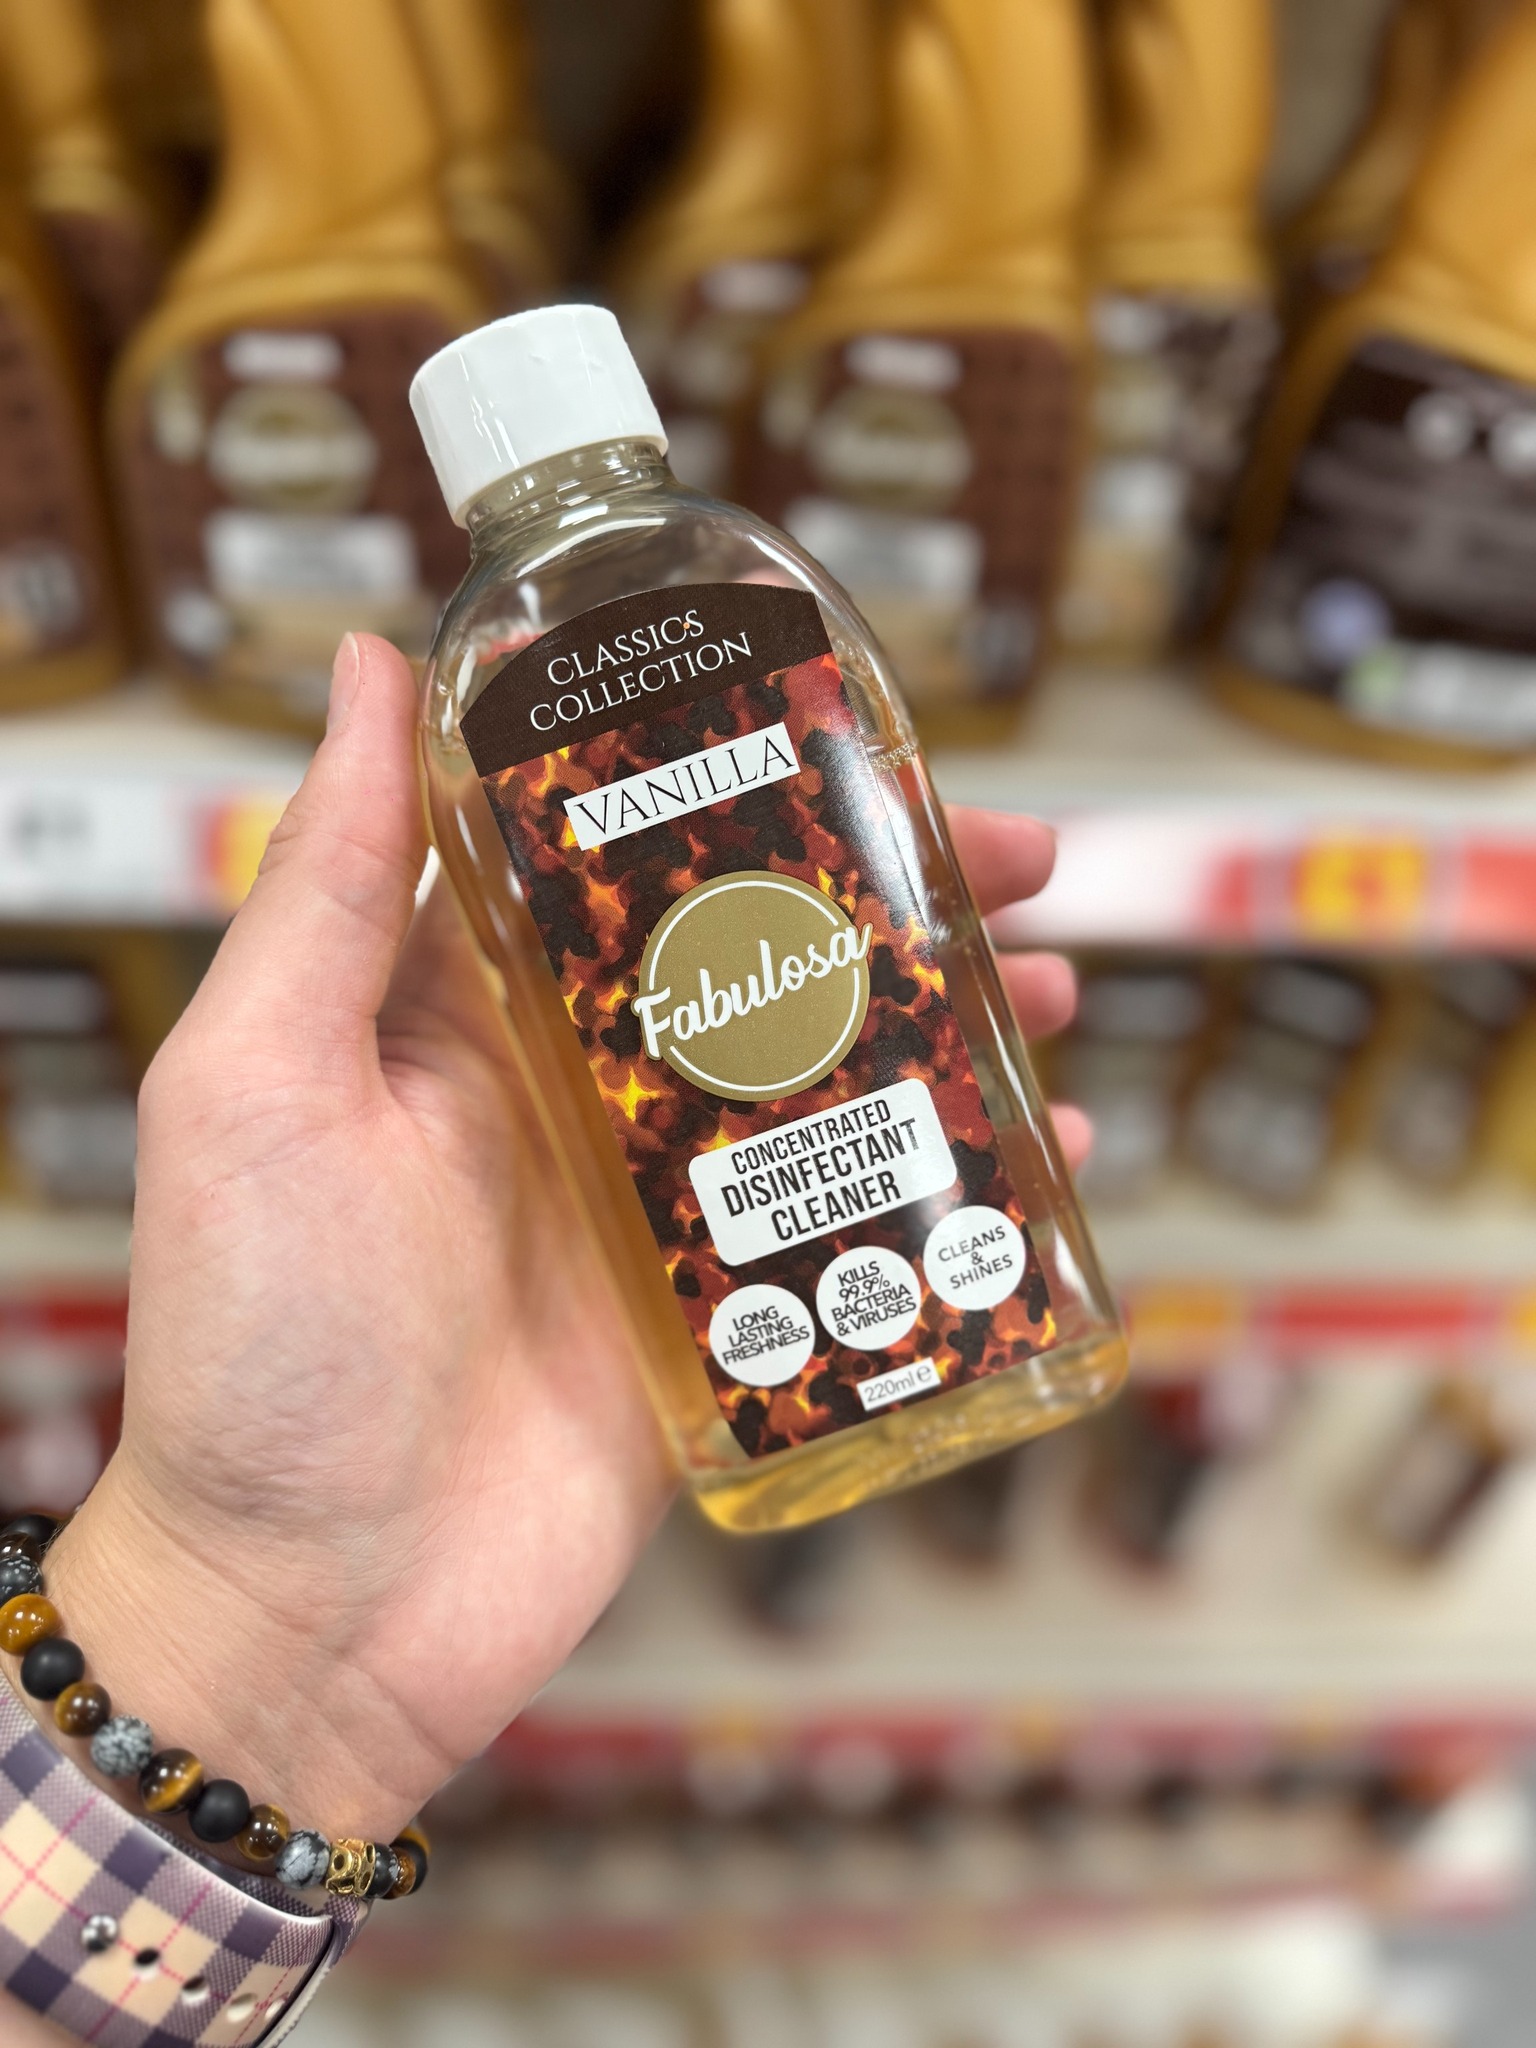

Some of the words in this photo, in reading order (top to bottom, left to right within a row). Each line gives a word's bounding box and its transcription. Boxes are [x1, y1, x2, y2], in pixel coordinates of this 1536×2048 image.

[547, 610, 704, 686] CLASSICS
[529, 631, 752, 731] COLLECTION
[573, 736, 794, 835] VANILLA
[634, 923, 871, 1058] Fabulosa
[731, 1099, 891, 1175] CONCENTRATED
[720, 1117, 920, 1217] DISINFECTANT
[771, 1170, 902, 1241] CLEANER
[937, 1225, 1006, 1263] CLEANS
[970, 1250, 985, 1266] &
[837, 1261, 881, 1287] KILLS
[838, 1273, 891, 1302] 99.9%
[949, 1254, 1014, 1290] SHINES
[732, 1305, 780, 1331] LONG
[831, 1283, 911, 1322] BACTERIA
[836, 1321, 851, 1337] &
[849, 1297, 917, 1333] VIRUSES
[721, 1326, 811, 1366] FRESHNESS
[727, 1316, 794, 1348] LASTING
[863, 1371, 916, 1403] 220ml
